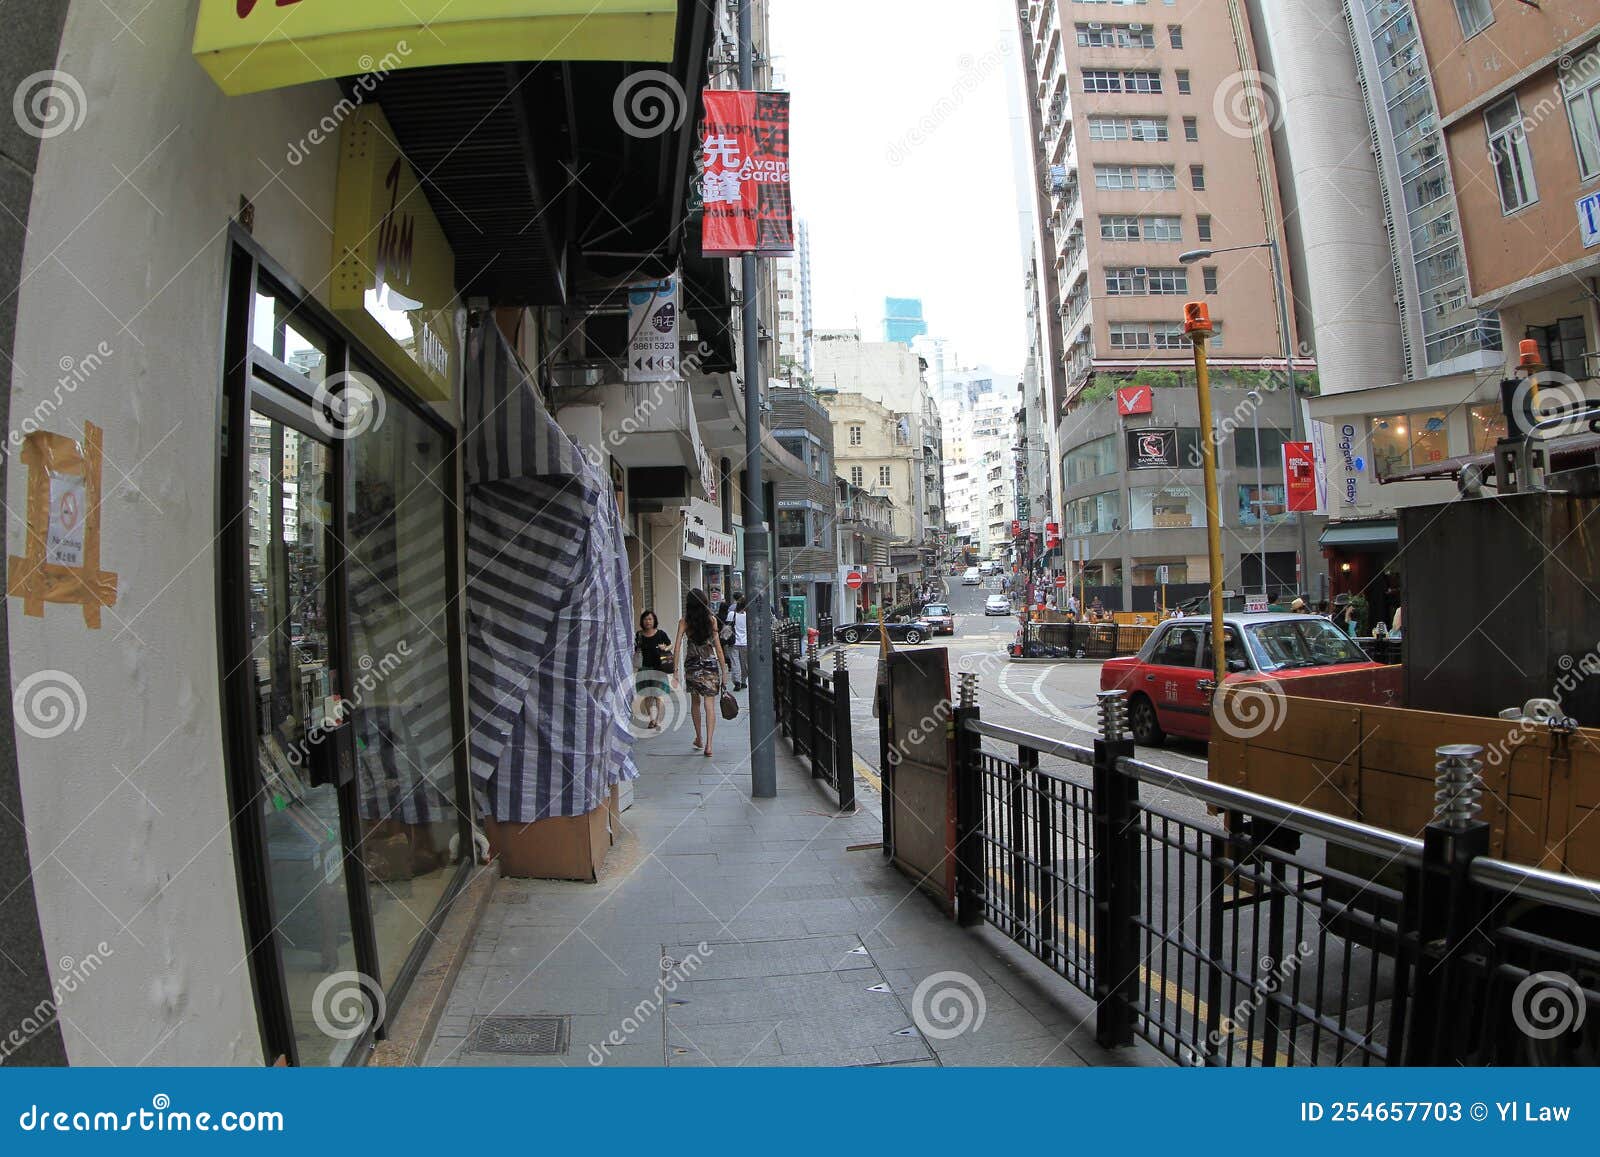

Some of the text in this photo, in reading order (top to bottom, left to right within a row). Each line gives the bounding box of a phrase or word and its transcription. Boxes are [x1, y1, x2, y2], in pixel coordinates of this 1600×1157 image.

[740, 167, 790, 182] Garde
[1339, 424, 1357, 504] Organic Baby
[1249, 603, 1267, 611] TAXI
